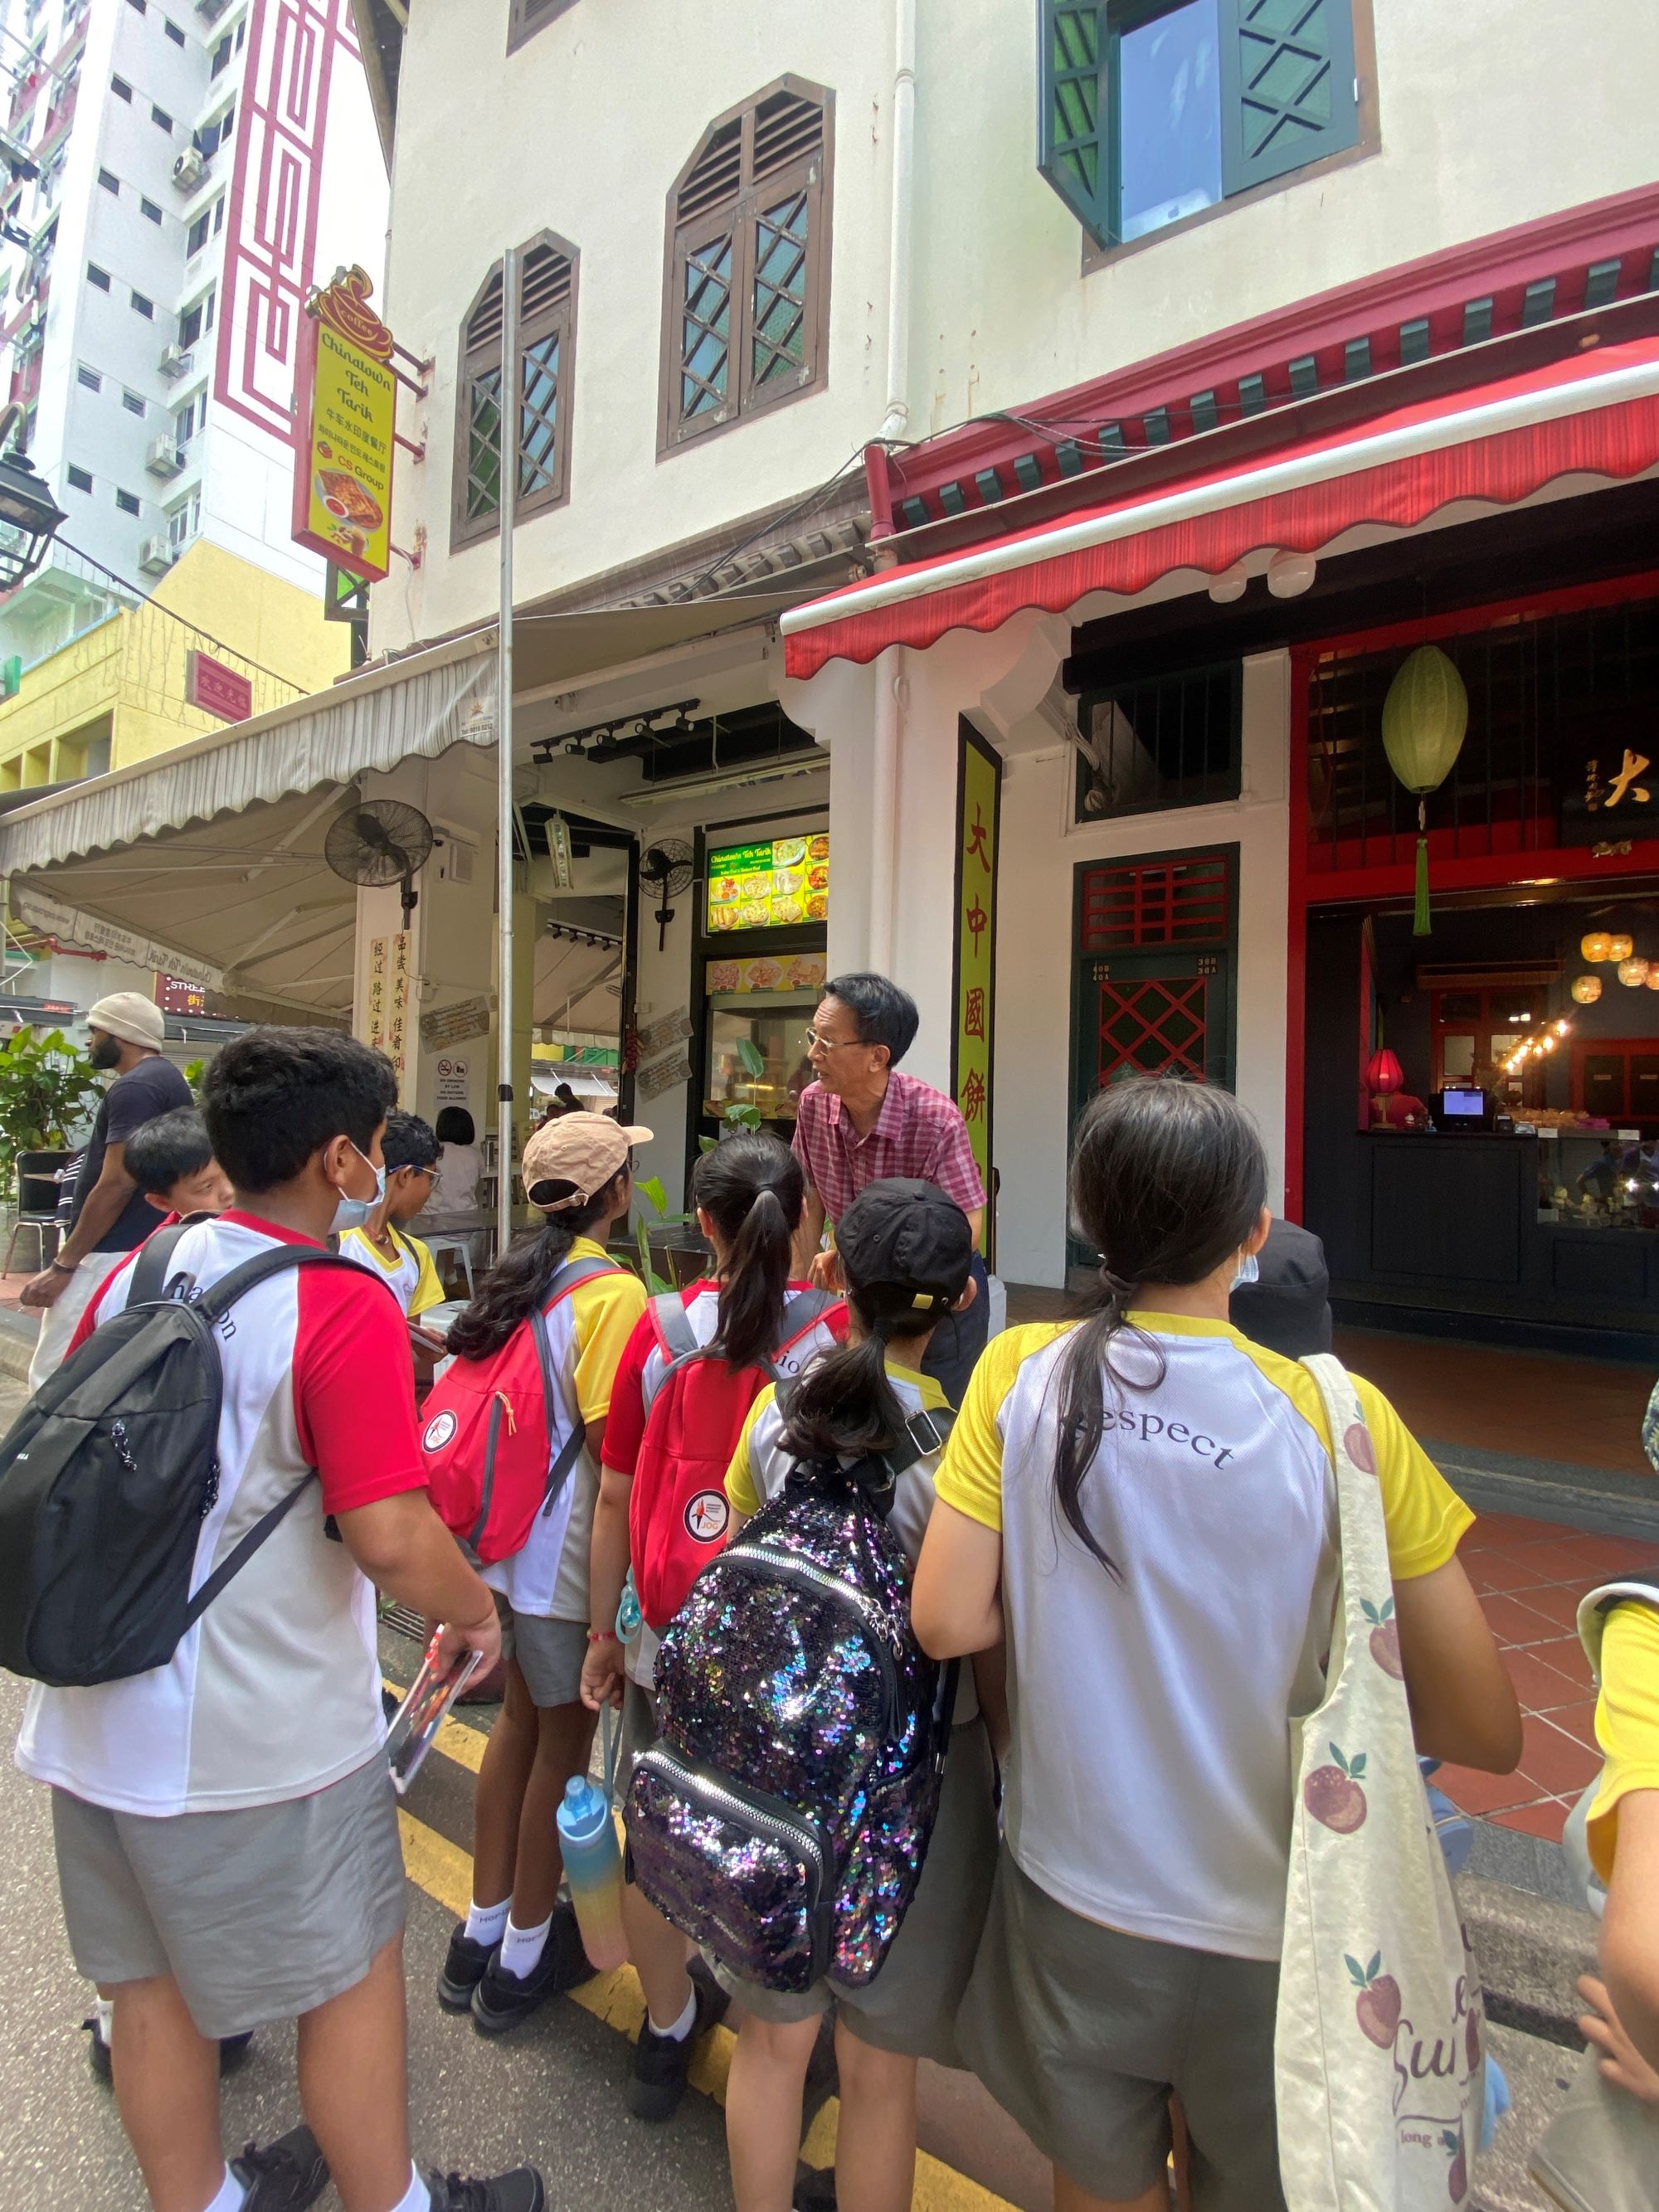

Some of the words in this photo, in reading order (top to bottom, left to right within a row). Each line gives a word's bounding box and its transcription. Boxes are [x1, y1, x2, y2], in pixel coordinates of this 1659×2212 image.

[341, 310, 372, 336] coffee
[322, 333, 392, 391] Chinatown
[345, 369, 369, 397] Teh
[337, 387, 373, 423] Tarik
[326, 407, 387, 455] 牛车水印度餐厅
[338, 455, 353, 471] CS
[354, 465, 384, 491] Group
[170, 981, 206, 993] STREE
[960, 801, 992, 1178] 大中國餅
[701, 1522, 718, 1530] JOG
[1401, 2129, 1433, 2149] long
